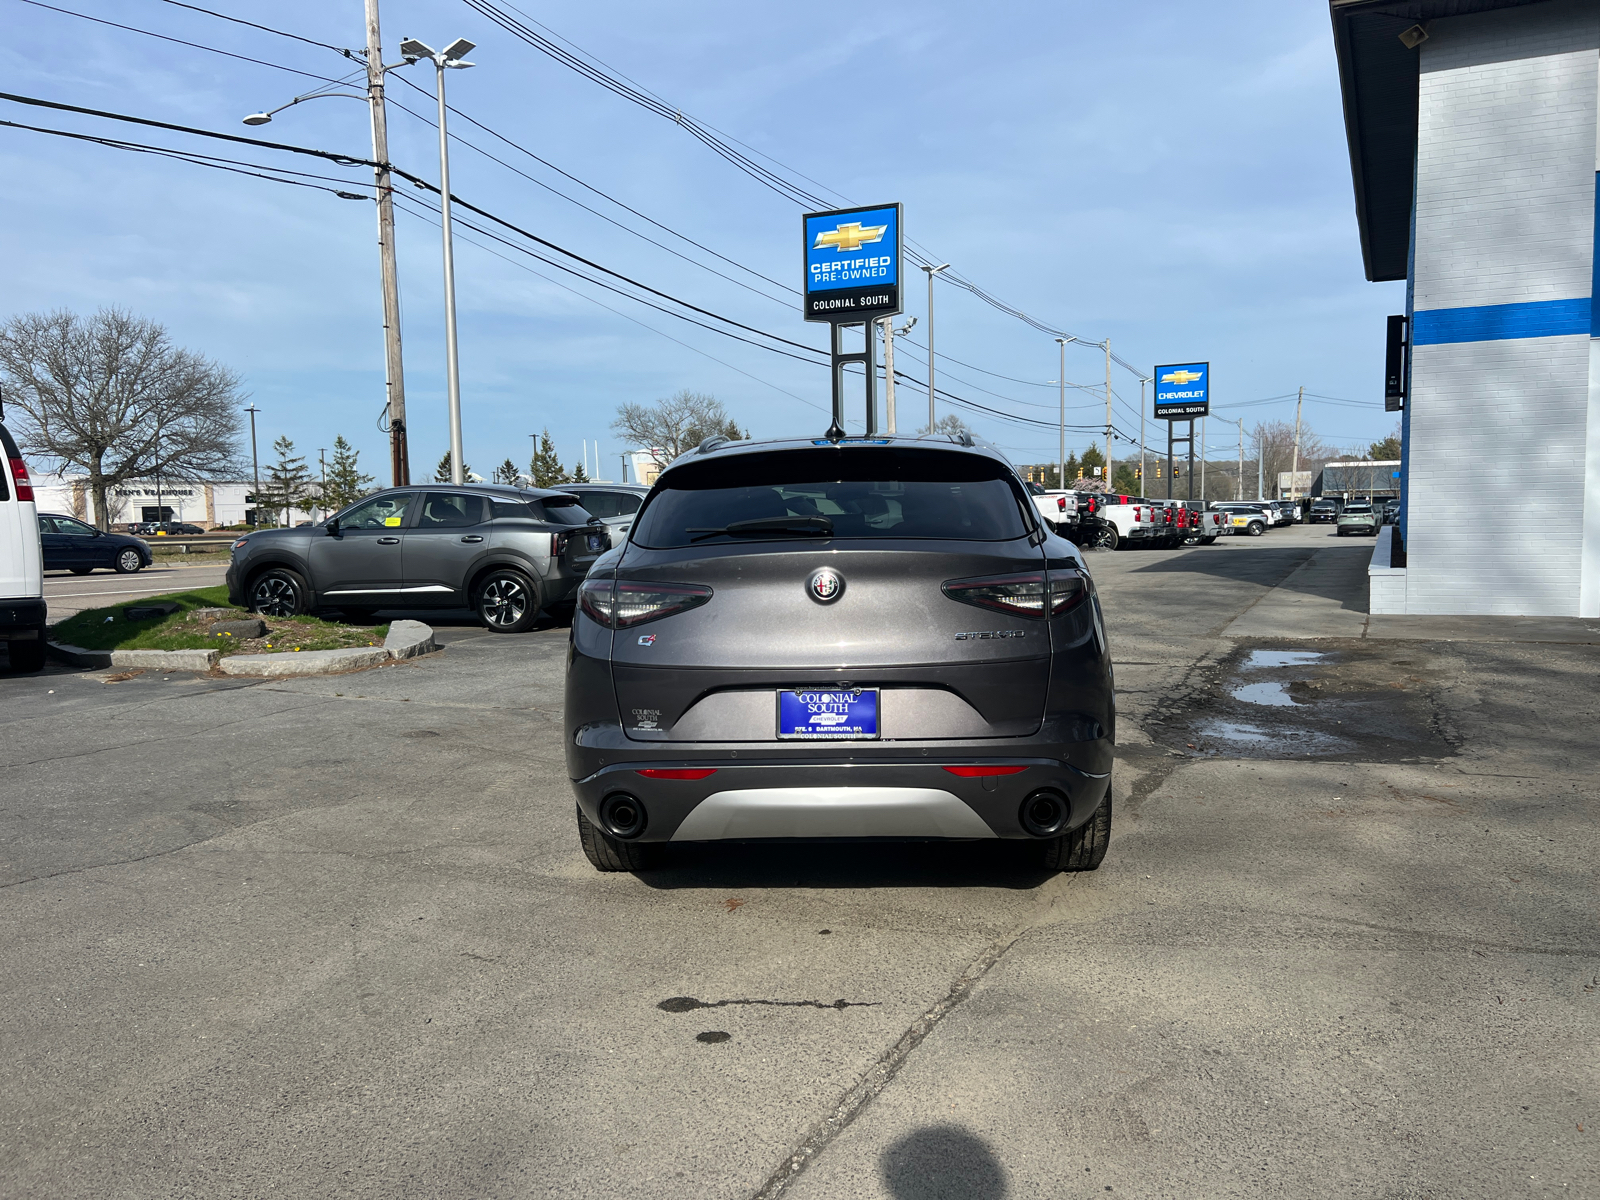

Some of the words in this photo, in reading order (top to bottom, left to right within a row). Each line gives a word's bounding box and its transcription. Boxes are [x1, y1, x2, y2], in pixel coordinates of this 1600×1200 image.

[810, 256, 891, 273] CERTIFIED
[814, 267, 887, 282] PRE-OWNED
[813, 298, 856, 311] COLONIAL
[860, 295, 889, 307] SOUTH
[1158, 390, 1204, 400] CHEVROLET
[954, 629, 1026, 641] STELVIO
[799, 694, 858, 704] COLONIAL
[808, 703, 849, 713] SOUTH
